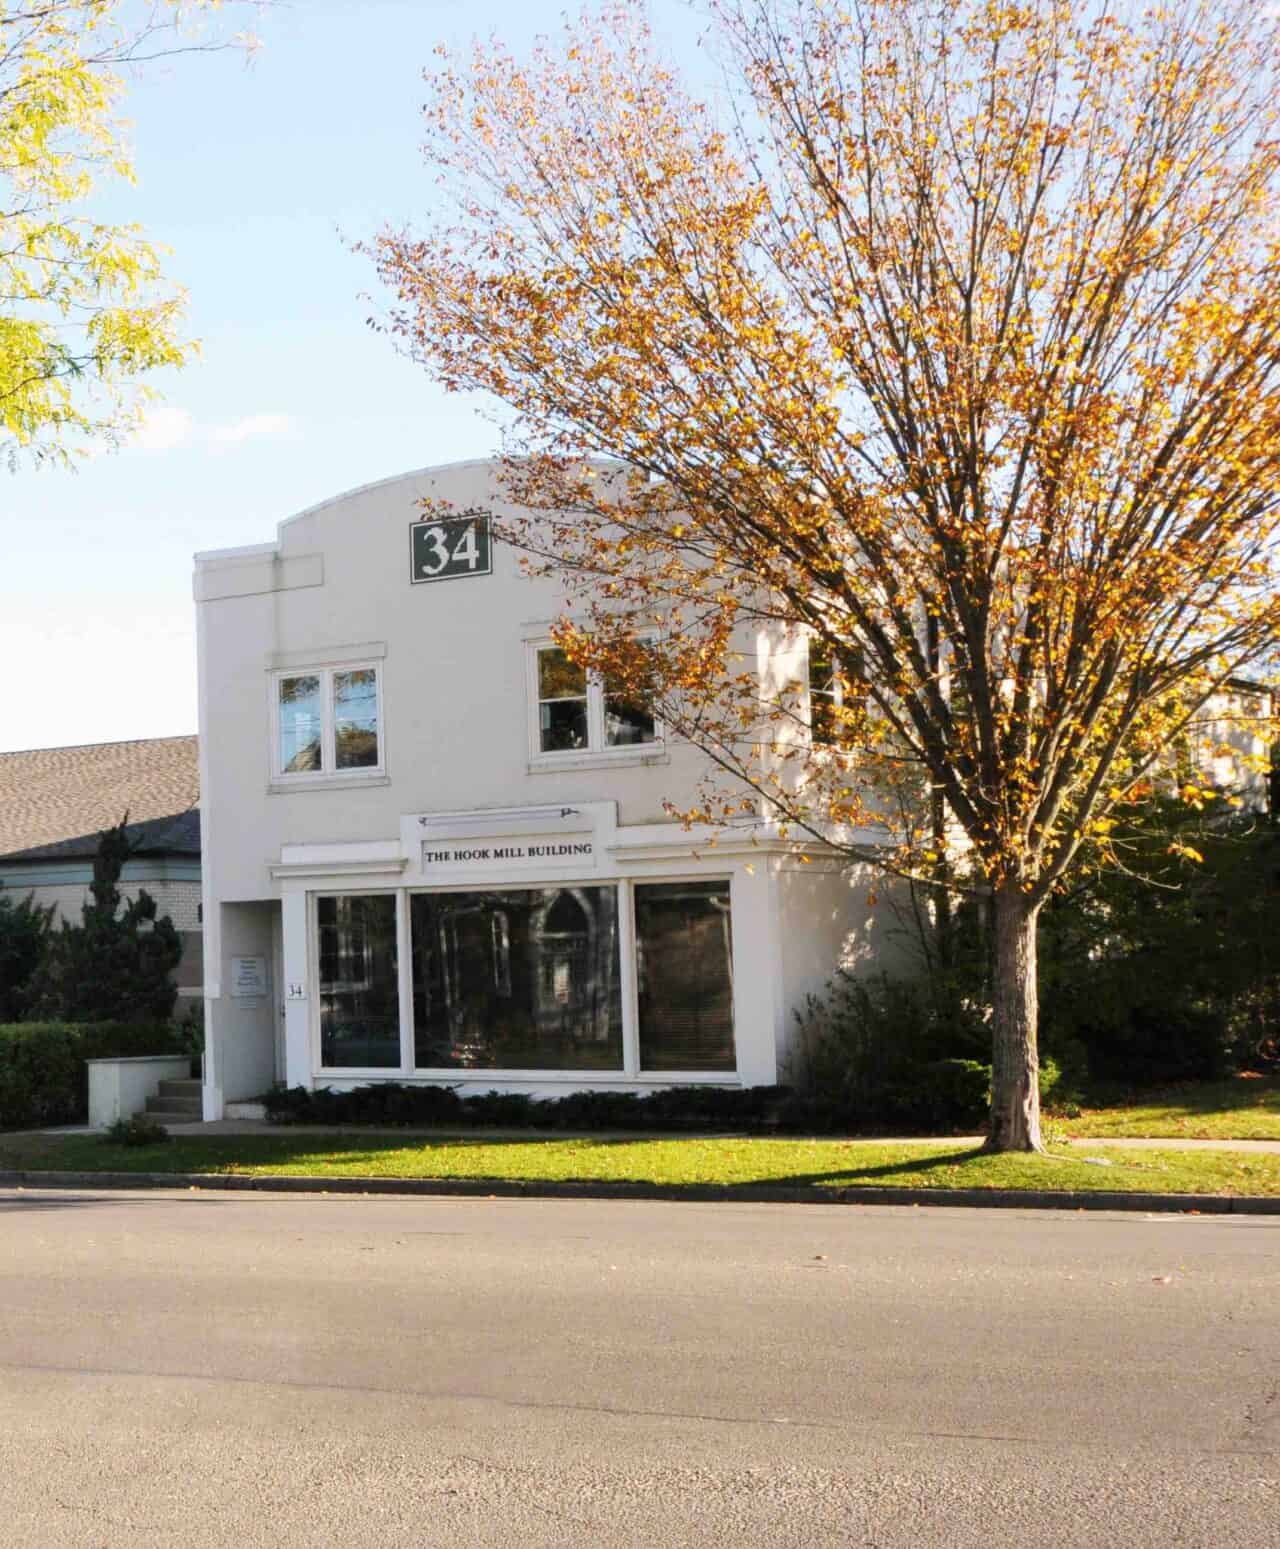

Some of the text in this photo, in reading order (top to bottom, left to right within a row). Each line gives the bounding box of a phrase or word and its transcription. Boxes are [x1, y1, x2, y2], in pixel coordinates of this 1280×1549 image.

[422, 519, 480, 575] 34
[426, 843, 592, 863] THE HOOK MILL BUILDING
